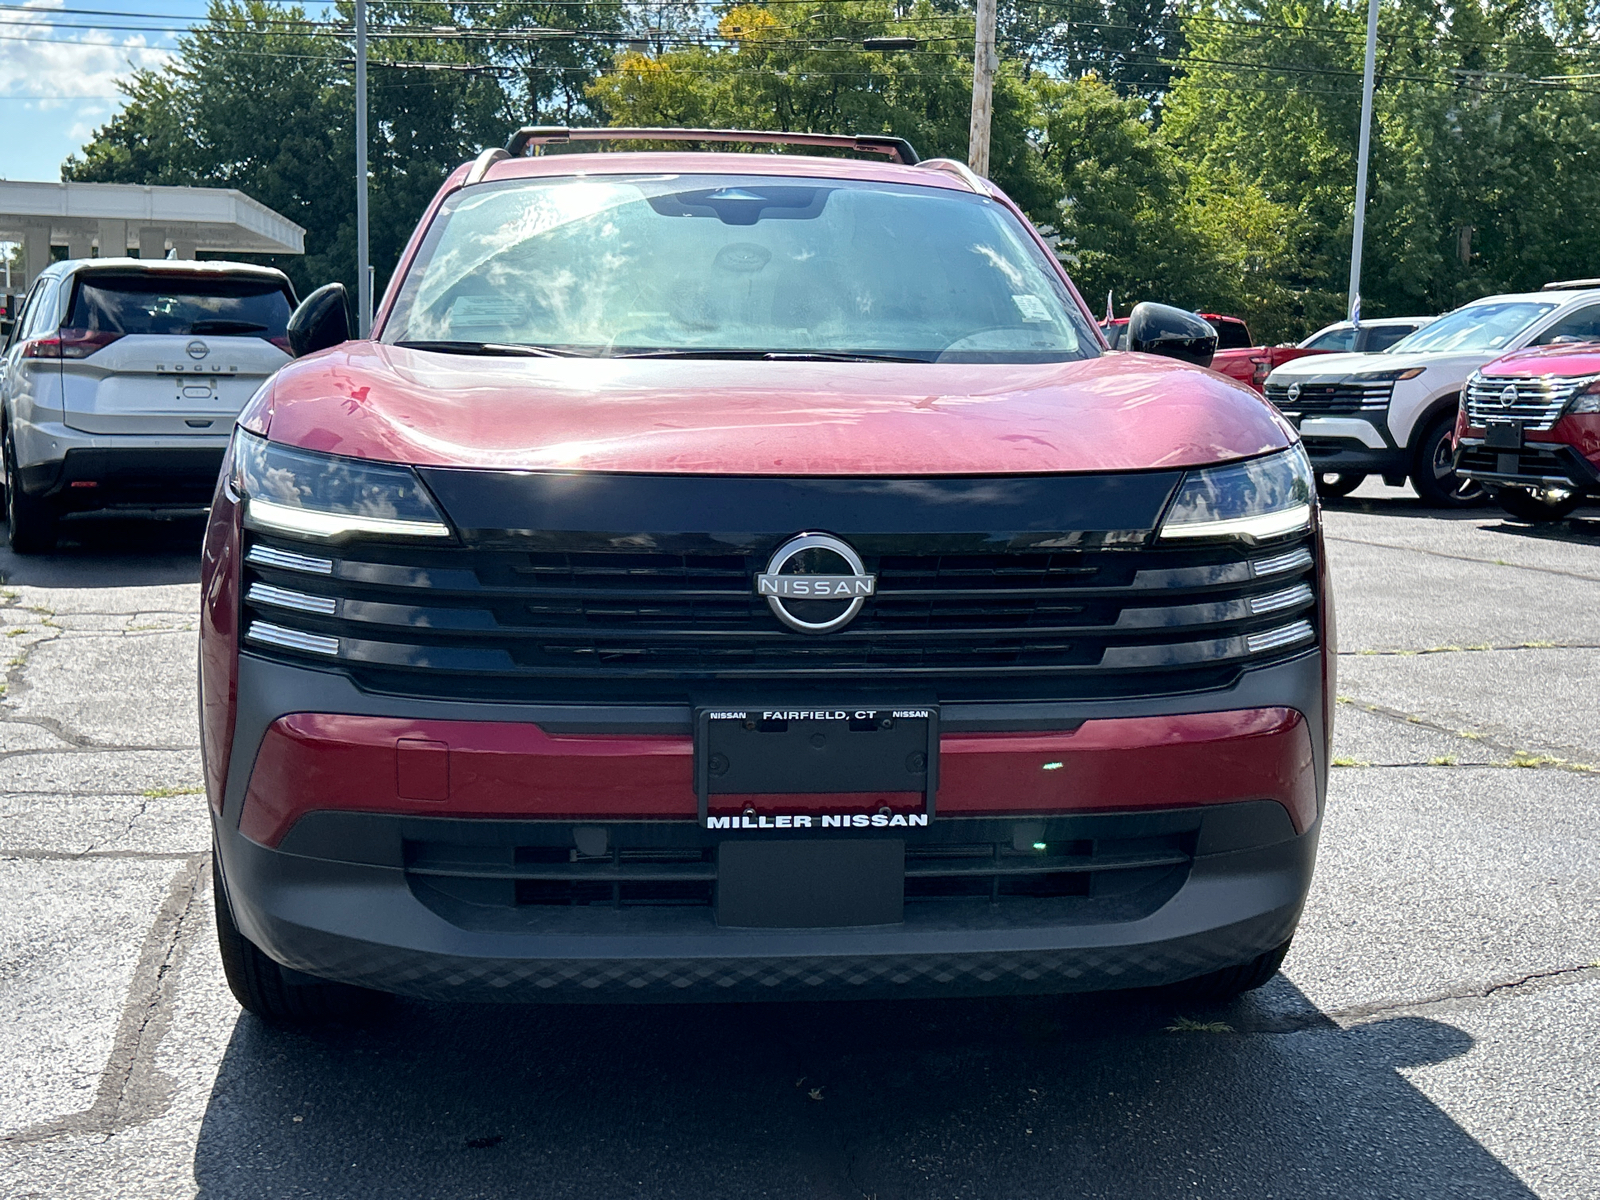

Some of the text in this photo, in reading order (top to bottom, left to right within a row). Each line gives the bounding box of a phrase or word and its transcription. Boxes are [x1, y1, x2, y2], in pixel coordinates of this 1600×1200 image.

[156, 364, 238, 372] ROGUE
[761, 579, 871, 595] NISSAN
[709, 711, 747, 720] NISSAN
[762, 710, 877, 721] FAIRFIELD, CT
[892, 710, 929, 718] NISSAN
[706, 814, 928, 829] MILLER NISSAN
